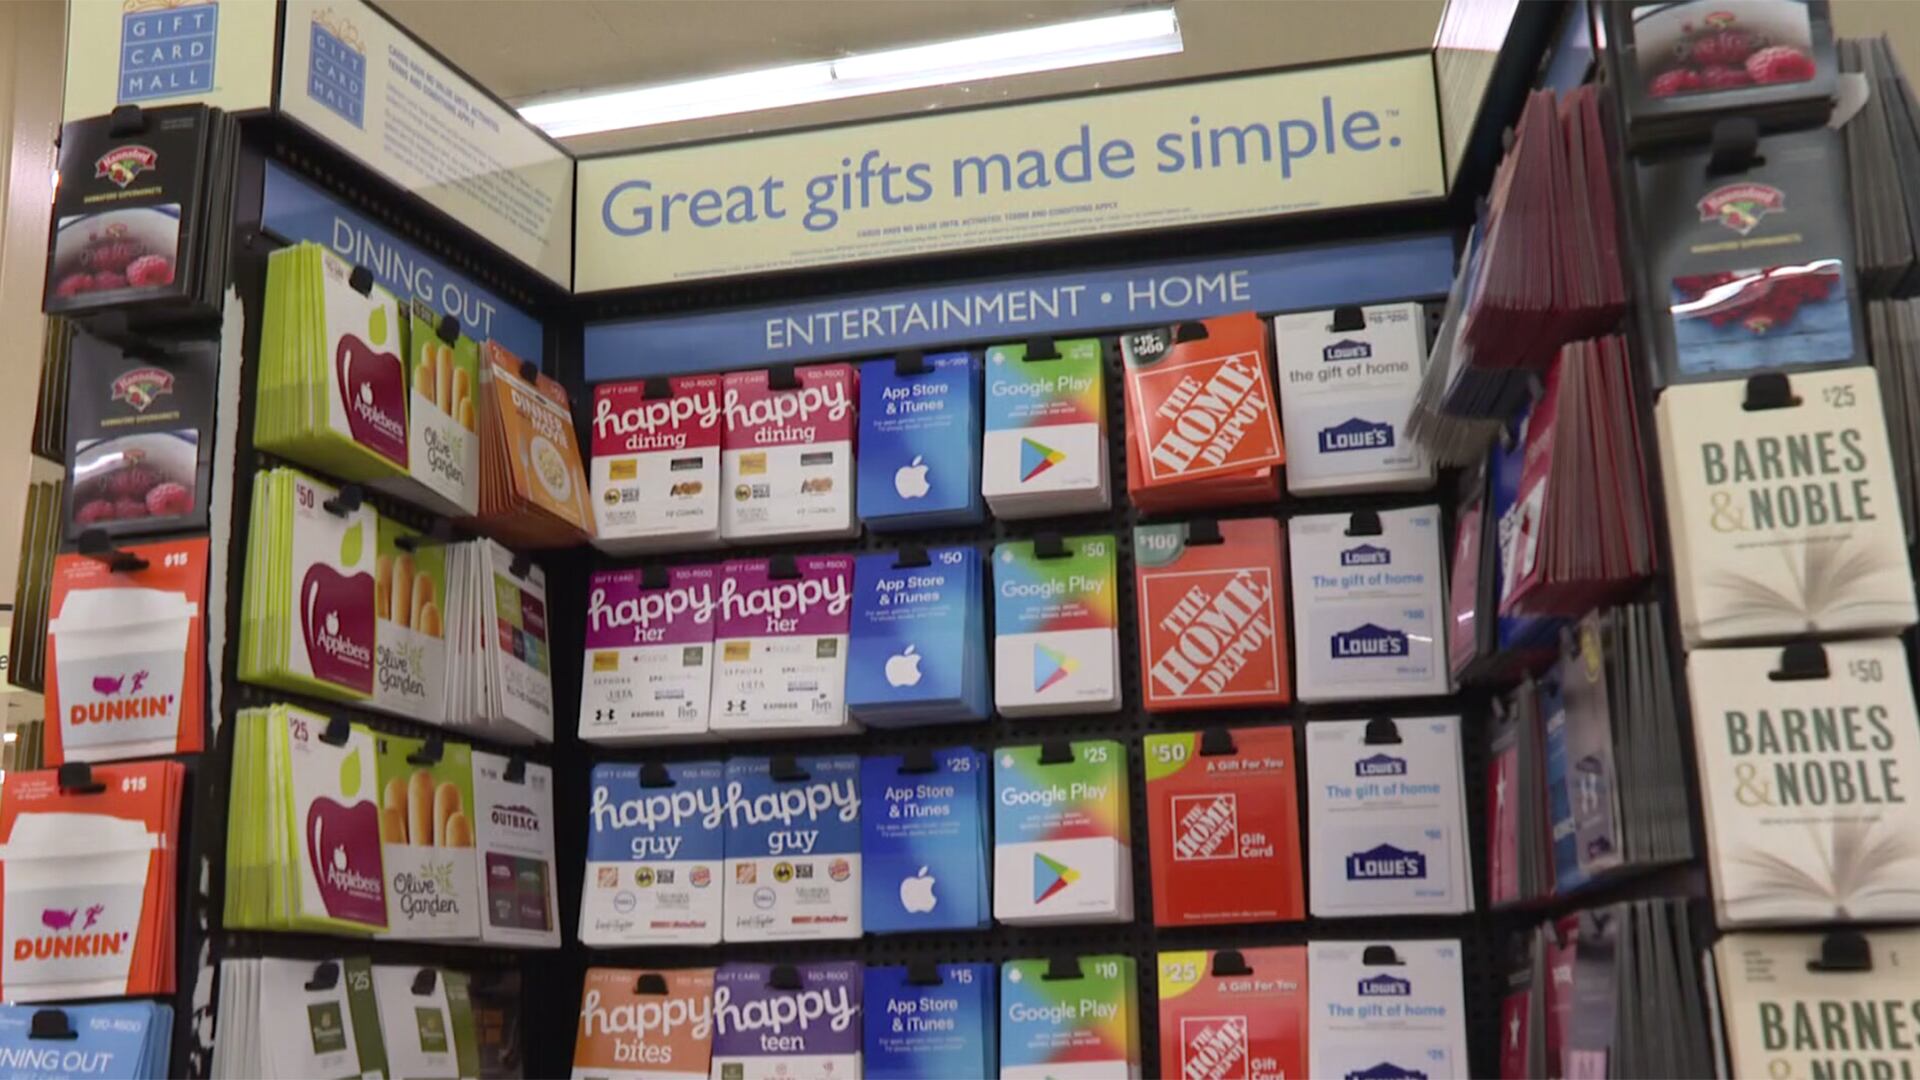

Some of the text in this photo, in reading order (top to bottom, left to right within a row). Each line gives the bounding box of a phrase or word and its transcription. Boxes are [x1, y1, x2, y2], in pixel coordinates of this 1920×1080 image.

[133, 14, 205, 37] GIFT
[131, 42, 205, 65] CARD
[317, 35, 360, 71] GIFT
[128, 70, 200, 92] MALL
[315, 60, 360, 94] CARD
[314, 81, 359, 117] MALL
[602, 96, 1402, 237] Great gifts made simple.
[332, 217, 496, 334] DINING OUT
[765, 270, 1251, 350] ENTERTAINMENT HOME
[1290, 361, 1409, 383] the gift of home
[882, 384, 949, 400] App Store
[991, 375, 1093, 399] Google Play
[1157, 375, 1203, 421] THE
[1822, 385, 1856, 408] $25
[592, 391, 722, 439] happy
[723, 382, 851, 430] happy
[886, 400, 944, 415] & iTunes
[1152, 355, 1262, 474] HOME
[424, 426, 450, 456] Olive
[626, 431, 686, 450] dining
[755, 426, 816, 443] dining
[1201, 391, 1268, 468] DEPOT
[1326, 428, 1388, 449] LOWE'S
[427, 448, 465, 487] Garden
[1702, 428, 1867, 485] BARNES
[296, 484, 315, 509] $50
[1710, 479, 1877, 533] & NOBLE
[1139, 534, 1179, 550] $100
[939, 551, 963, 565] $50
[876, 575, 945, 592] App Store
[1001, 575, 1105, 598] Google Play
[1312, 572, 1424, 589] The gift of home
[588, 583, 719, 632] happy
[718, 574, 852, 621] happy
[879, 590, 941, 606] & iTunes
[1159, 584, 1211, 637] THE
[634, 625, 666, 643] her
[766, 615, 799, 633] her
[1151, 568, 1270, 697] HOME
[1200, 613, 1273, 695] DEPOT
[1338, 636, 1401, 655] LOWE'S
[379, 666, 426, 699] Garden
[1848, 659, 1884, 682] $50
[70, 695, 174, 726] DUNKIN'
[290, 716, 309, 743] $25
[1724, 704, 1895, 755] BARNES
[948, 757, 970, 772] $25
[1151, 743, 1186, 762] $50
[1218, 759, 1240, 771] Gift
[1242, 758, 1261, 770] For
[1262, 757, 1284, 768] You
[884, 784, 954, 801] App Store
[1001, 783, 1109, 807] Google Play
[1325, 782, 1441, 800] The gift of home
[1734, 758, 1906, 808] & NOBLE
[590, 786, 726, 832] happy
[722, 779, 862, 827] happy
[889, 803, 950, 819] & iTunes
[1181, 802, 1204, 828] THE
[491, 811, 541, 832] OUTBACK
[1175, 796, 1235, 860] HOME
[631, 836, 682, 859] guy
[768, 830, 819, 854] guy
[1199, 818, 1236, 859] DEPOT
[1240, 832, 1266, 845] Gift
[1241, 845, 1274, 858] Card
[1353, 857, 1419, 877] LOWE'S
[394, 872, 435, 896] Olive
[401, 894, 460, 920] Garden
[14, 931, 129, 961] DUNKIN'
[951, 968, 973, 984] $15
[1163, 963, 1198, 981] $25
[1228, 980, 1250, 992] Gift
[1252, 980, 1273, 991] For
[1275, 979, 1298, 990] You
[581, 990, 714, 1040] happy
[713, 986, 855, 1035] happy
[887, 997, 958, 1014] App Store
[1009, 999, 1118, 1023] Google Play
[1327, 1003, 1446, 1019] The gift of home
[892, 1017, 954, 1032] & iTunes
[1191, 1023, 1215, 1050] THE
[613, 1039, 672, 1063] bites
[760, 1033, 805, 1051] teen
[1184, 1016, 1247, 1080] HOME
[0, 1048, 113, 1073] NING OUT
[1250, 1056, 1277, 1071] Gift
